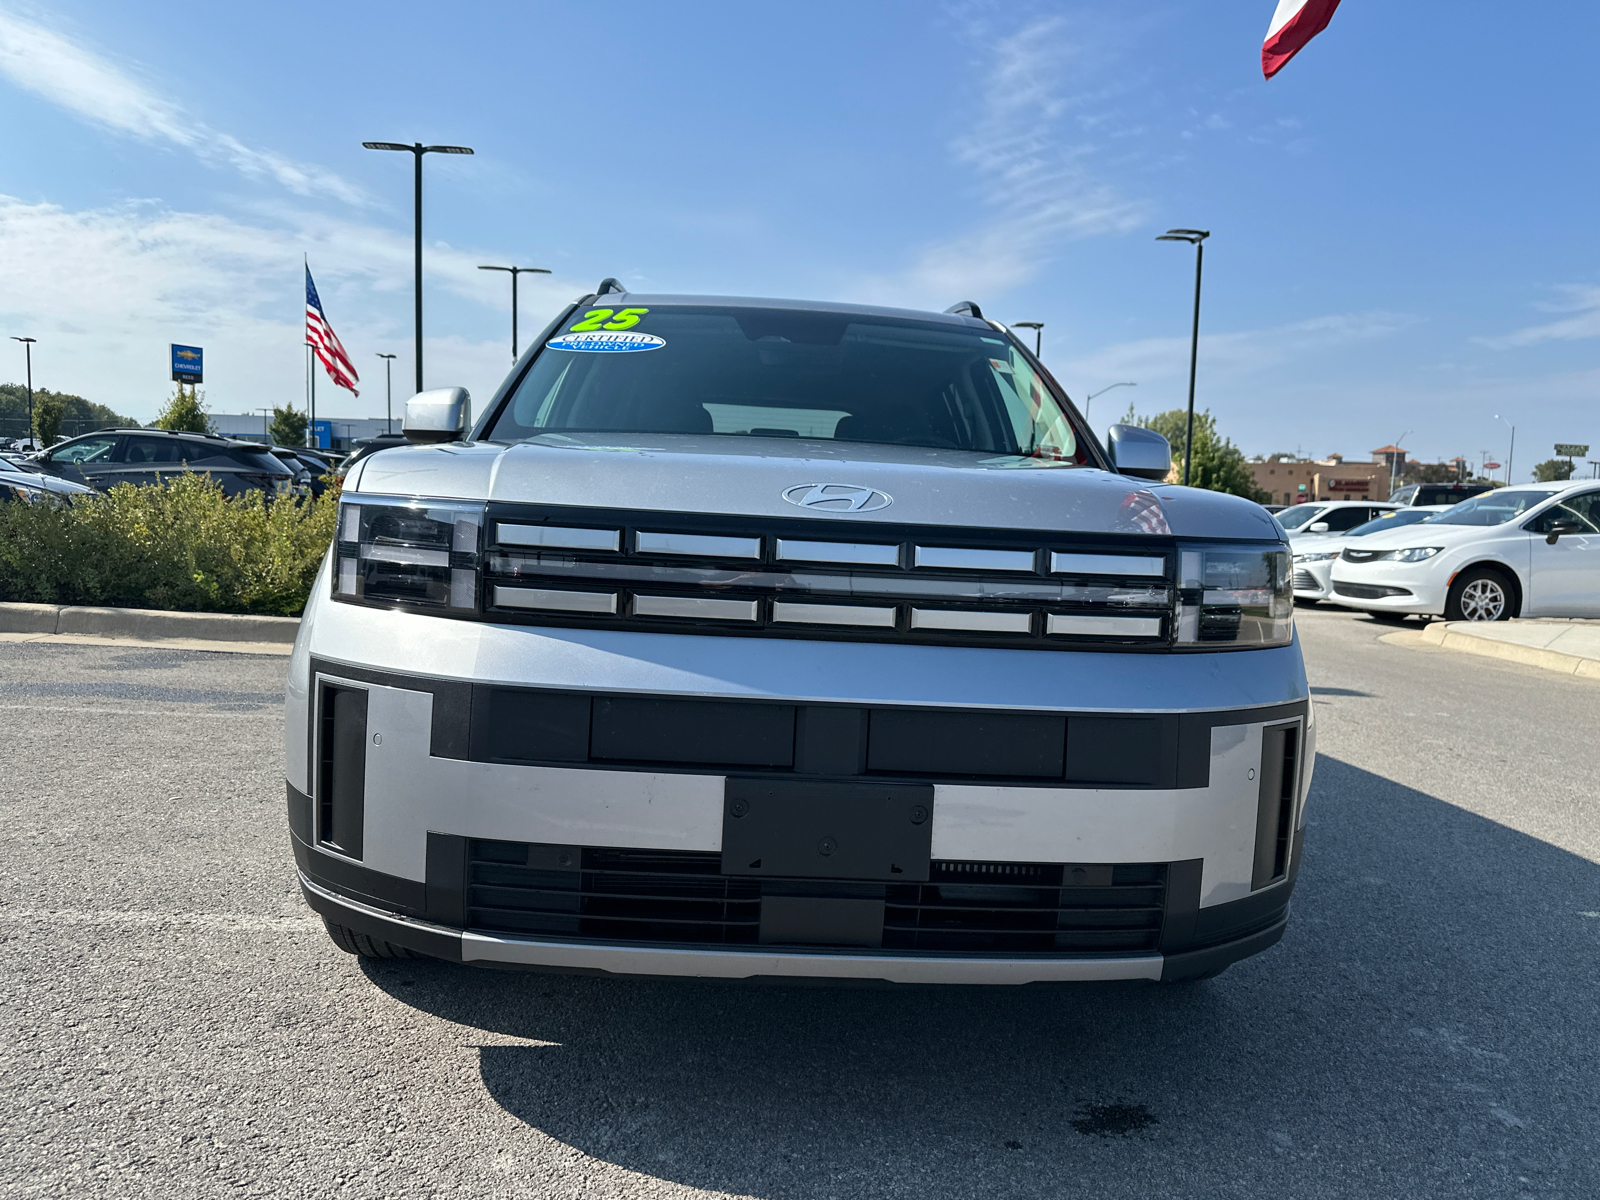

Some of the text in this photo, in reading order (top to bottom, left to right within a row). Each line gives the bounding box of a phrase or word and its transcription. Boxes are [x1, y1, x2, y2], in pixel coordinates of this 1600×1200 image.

[570, 308, 649, 331] 25
[562, 334, 654, 343] CERTIFIED
[174, 362, 202, 371] CHEVROLET
